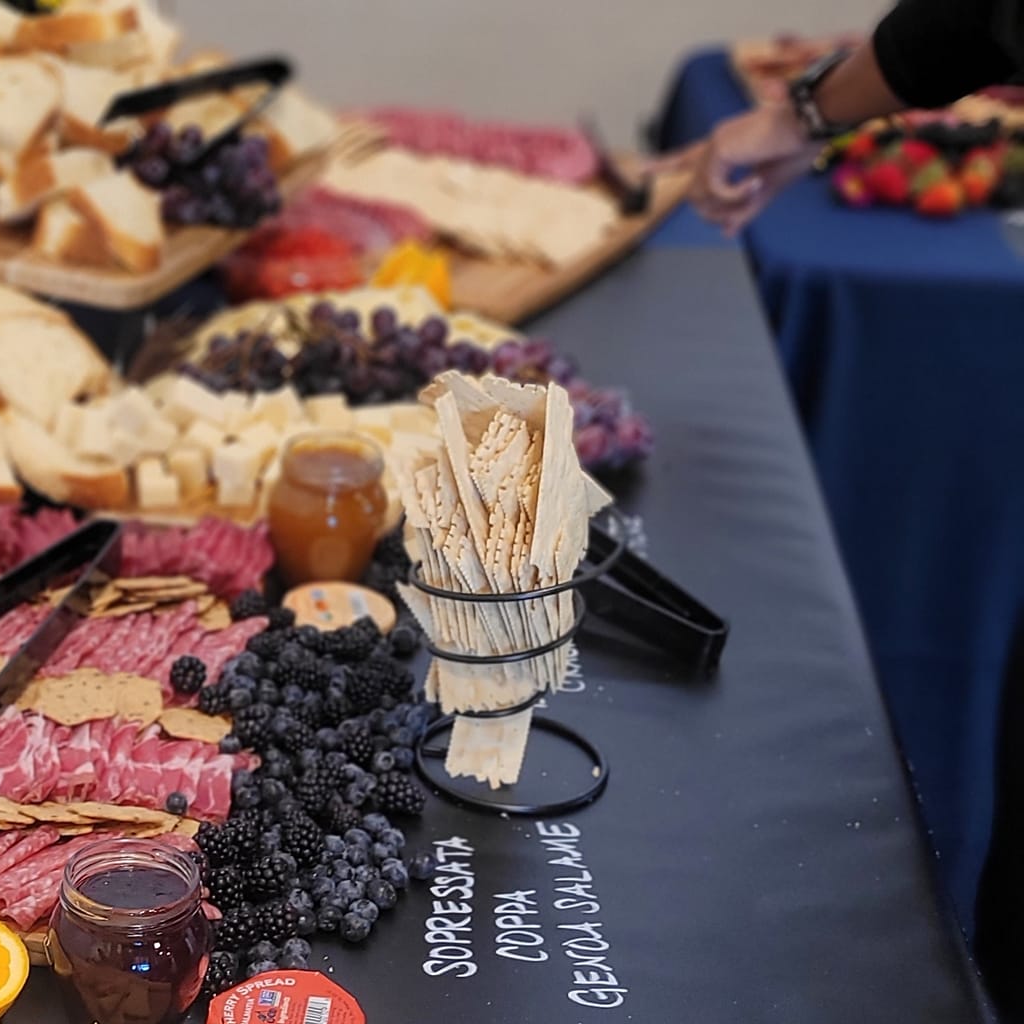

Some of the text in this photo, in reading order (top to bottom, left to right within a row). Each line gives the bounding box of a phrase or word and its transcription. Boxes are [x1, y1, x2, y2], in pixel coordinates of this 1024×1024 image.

[422, 835, 477, 977] SOPRESSATA
[494, 890, 549, 962] COPPA
[536, 820, 628, 1009] GENOA SALAME
[236, 978, 296, 996] SPREAD
